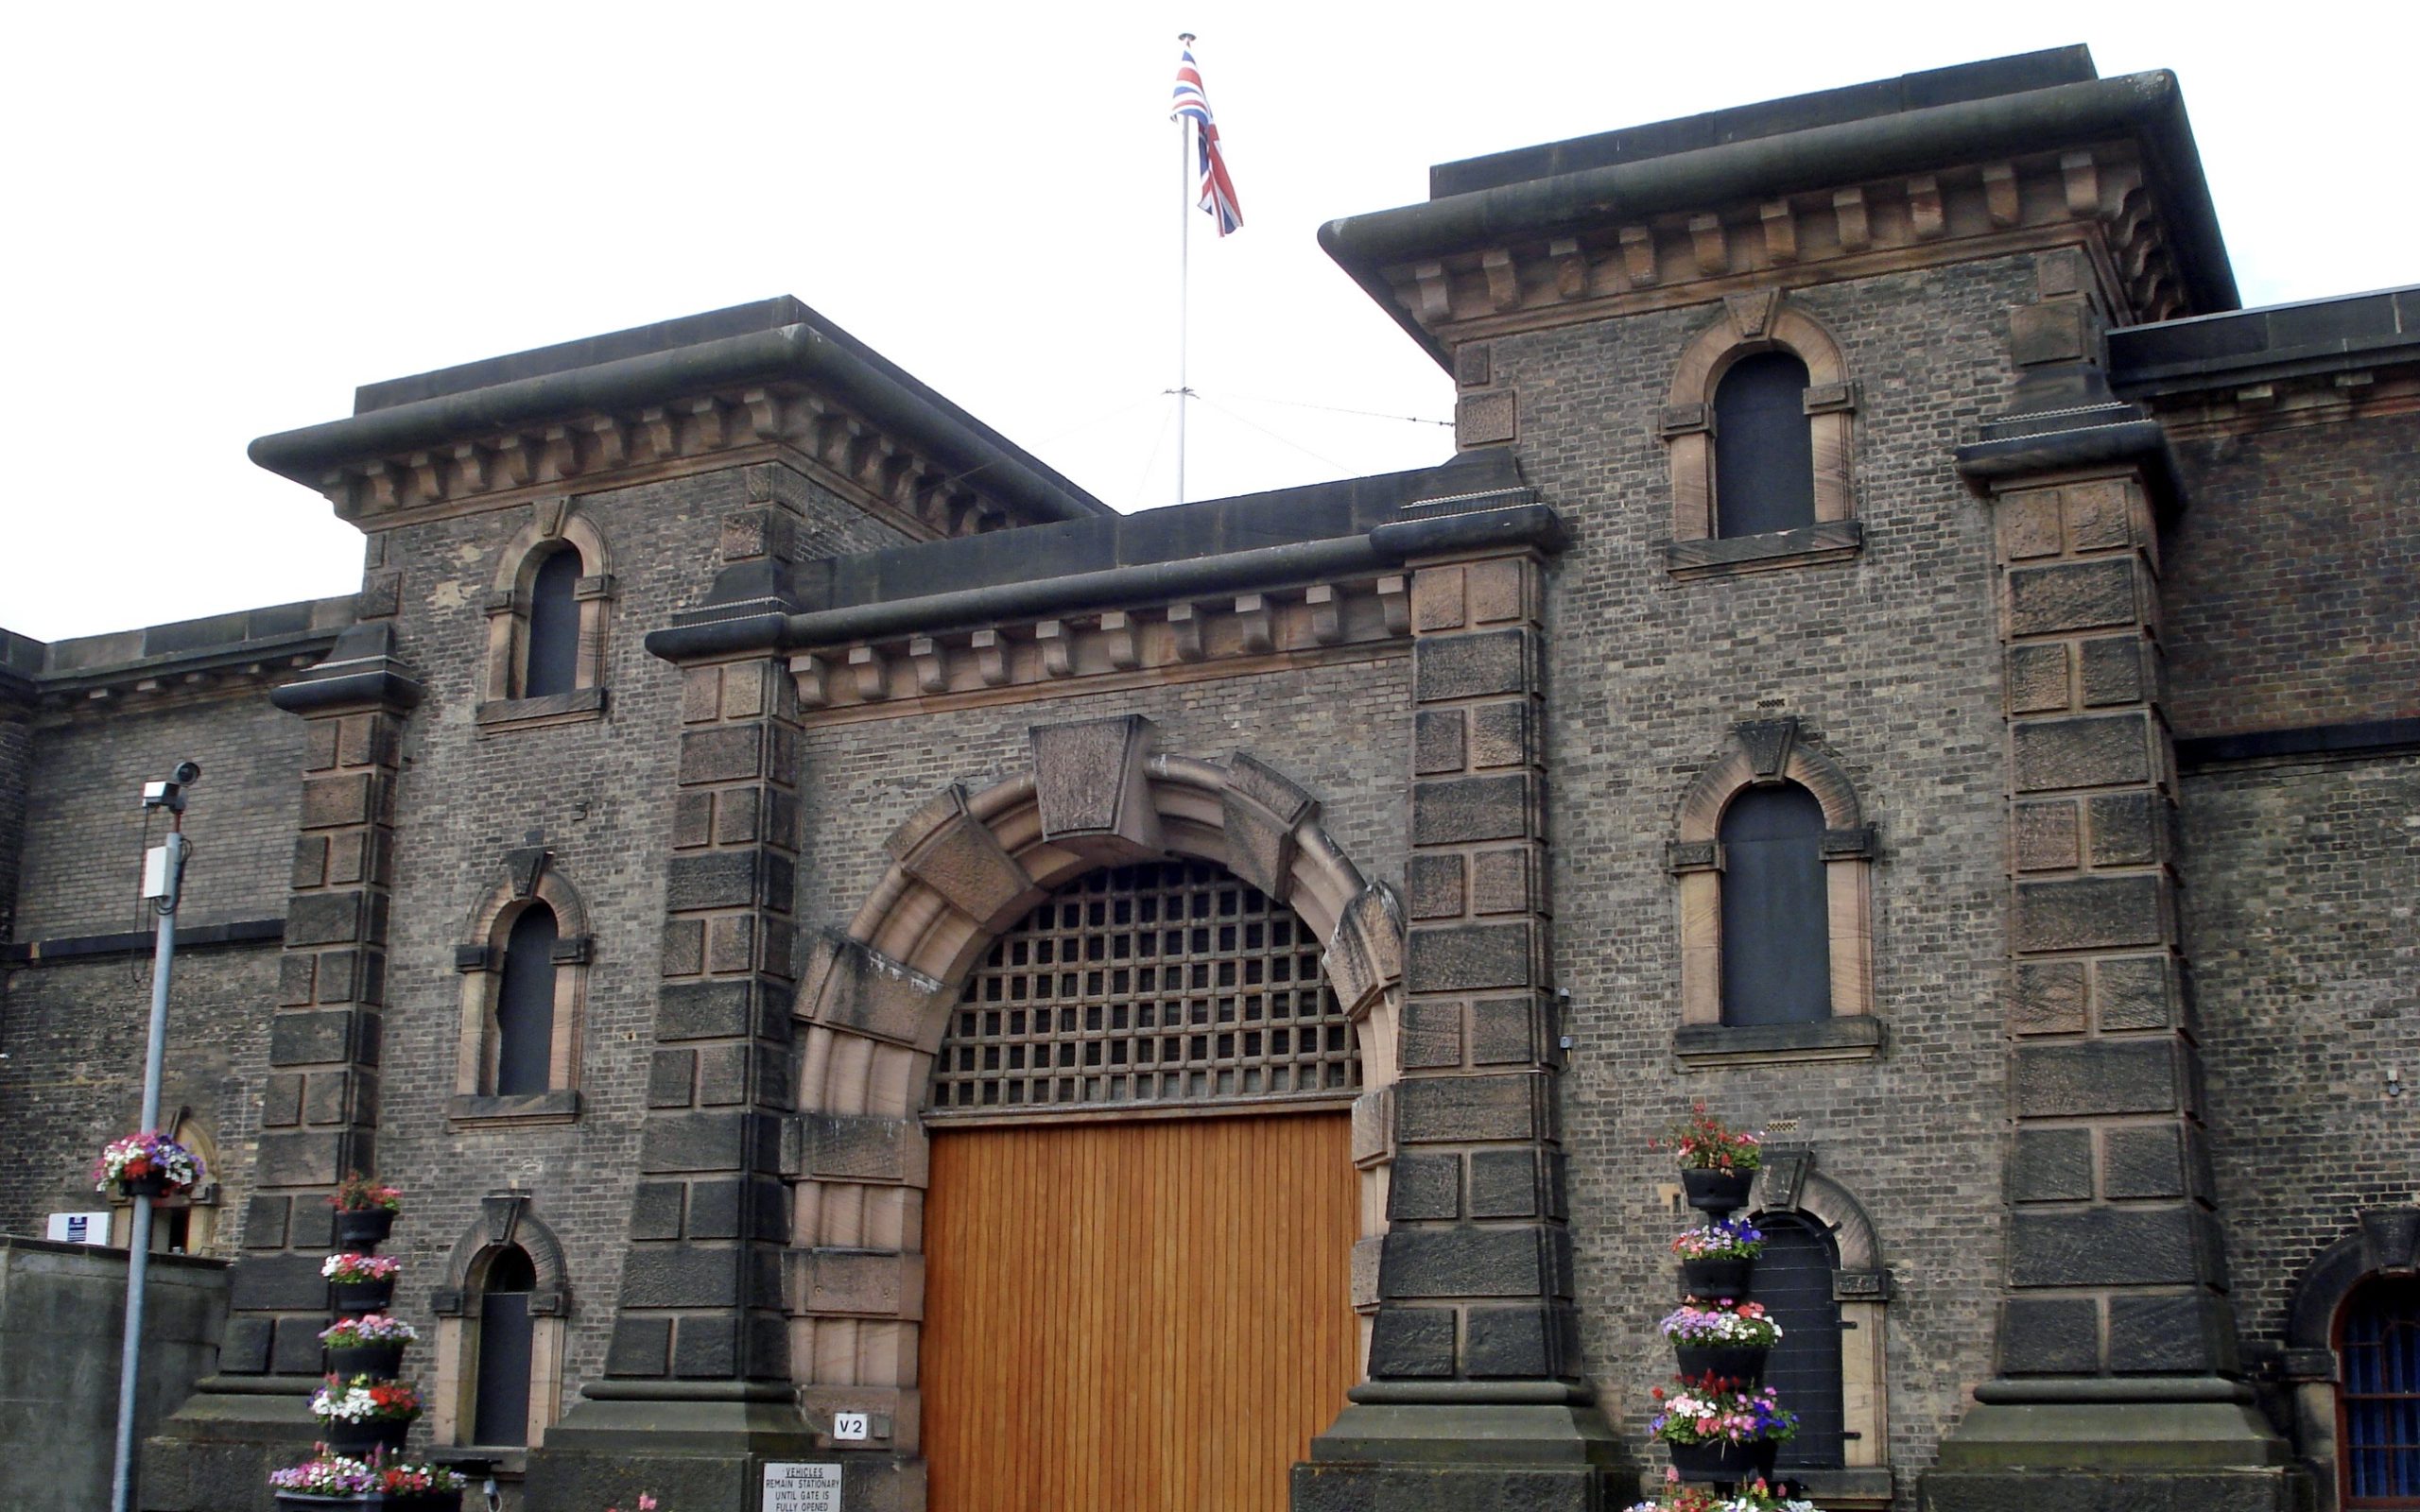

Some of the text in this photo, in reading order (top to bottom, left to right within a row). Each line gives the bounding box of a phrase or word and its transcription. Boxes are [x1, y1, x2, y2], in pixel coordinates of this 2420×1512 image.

[786, 1468, 823, 1477] VEHICLES
[766, 1479, 839, 1488] REMAIN STATIONARY
[775, 1491, 829, 1501] UNTIL GATE IS
[776, 1503, 828, 1512] FULLY OPENED
